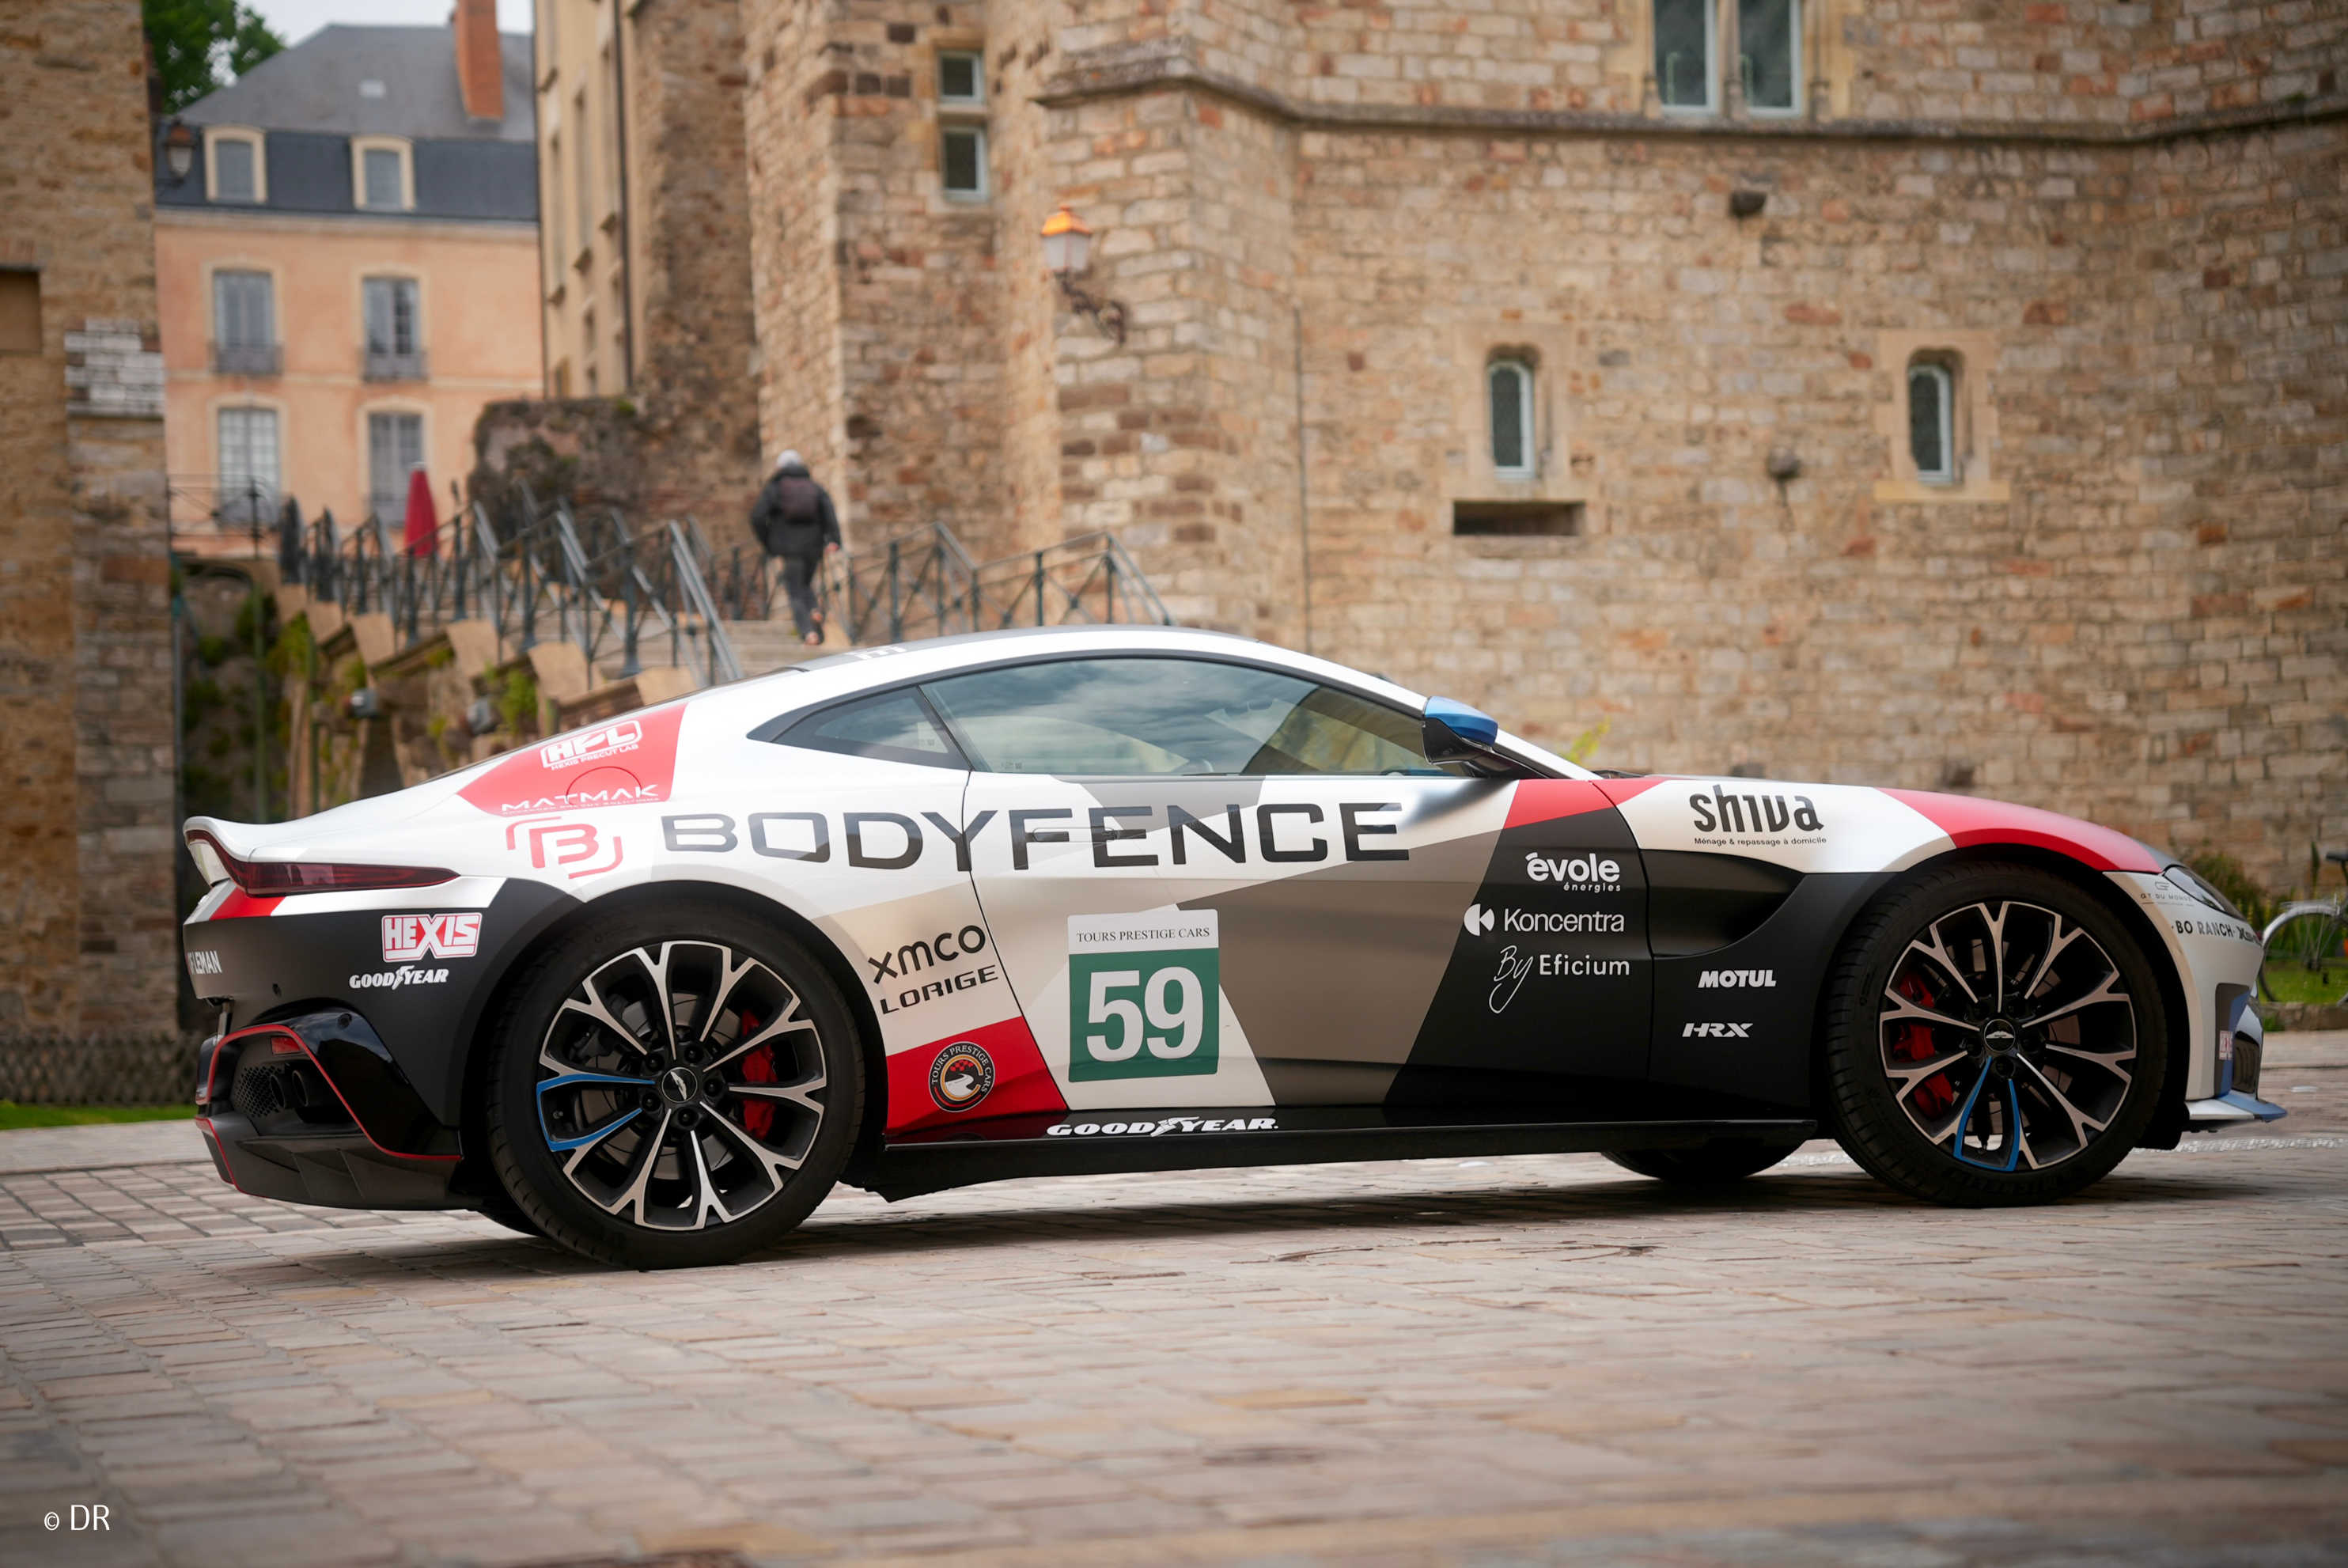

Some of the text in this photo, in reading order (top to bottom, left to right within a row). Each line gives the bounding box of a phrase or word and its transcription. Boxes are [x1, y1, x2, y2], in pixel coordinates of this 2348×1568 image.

[548, 726, 636, 763] HPL
[551, 743, 639, 771] HEXIS PRECUT LAB
[502, 784, 659, 812] MATMAK
[661, 802, 1411, 872] BODYFENCE
[1694, 836, 1727, 847] Ménage
[1737, 839, 1781, 847] repassage
[1790, 836, 1827, 845] domicile
[1524, 851, 1620, 883] évole
[1563, 882, 1621, 893] énergies
[1504, 907, 1625, 933] Koncentra
[2176, 920, 2194, 934] BO
[2196, 921, 2234, 937] RANCH
[383, 915, 481, 960] HEXIS
[1077, 927, 1210, 943] TOURS PRESTIGE CARS
[880, 964, 998, 1014] LORIGE
[1489, 945, 1630, 1014] By Eficium
[1698, 969, 1777, 988] MOTUL
[1086, 966, 1204, 1062] 59
[1682, 1023, 1754, 1037] HRX
[931, 1044, 992, 1093] TOURS PRESTIGE CARS
